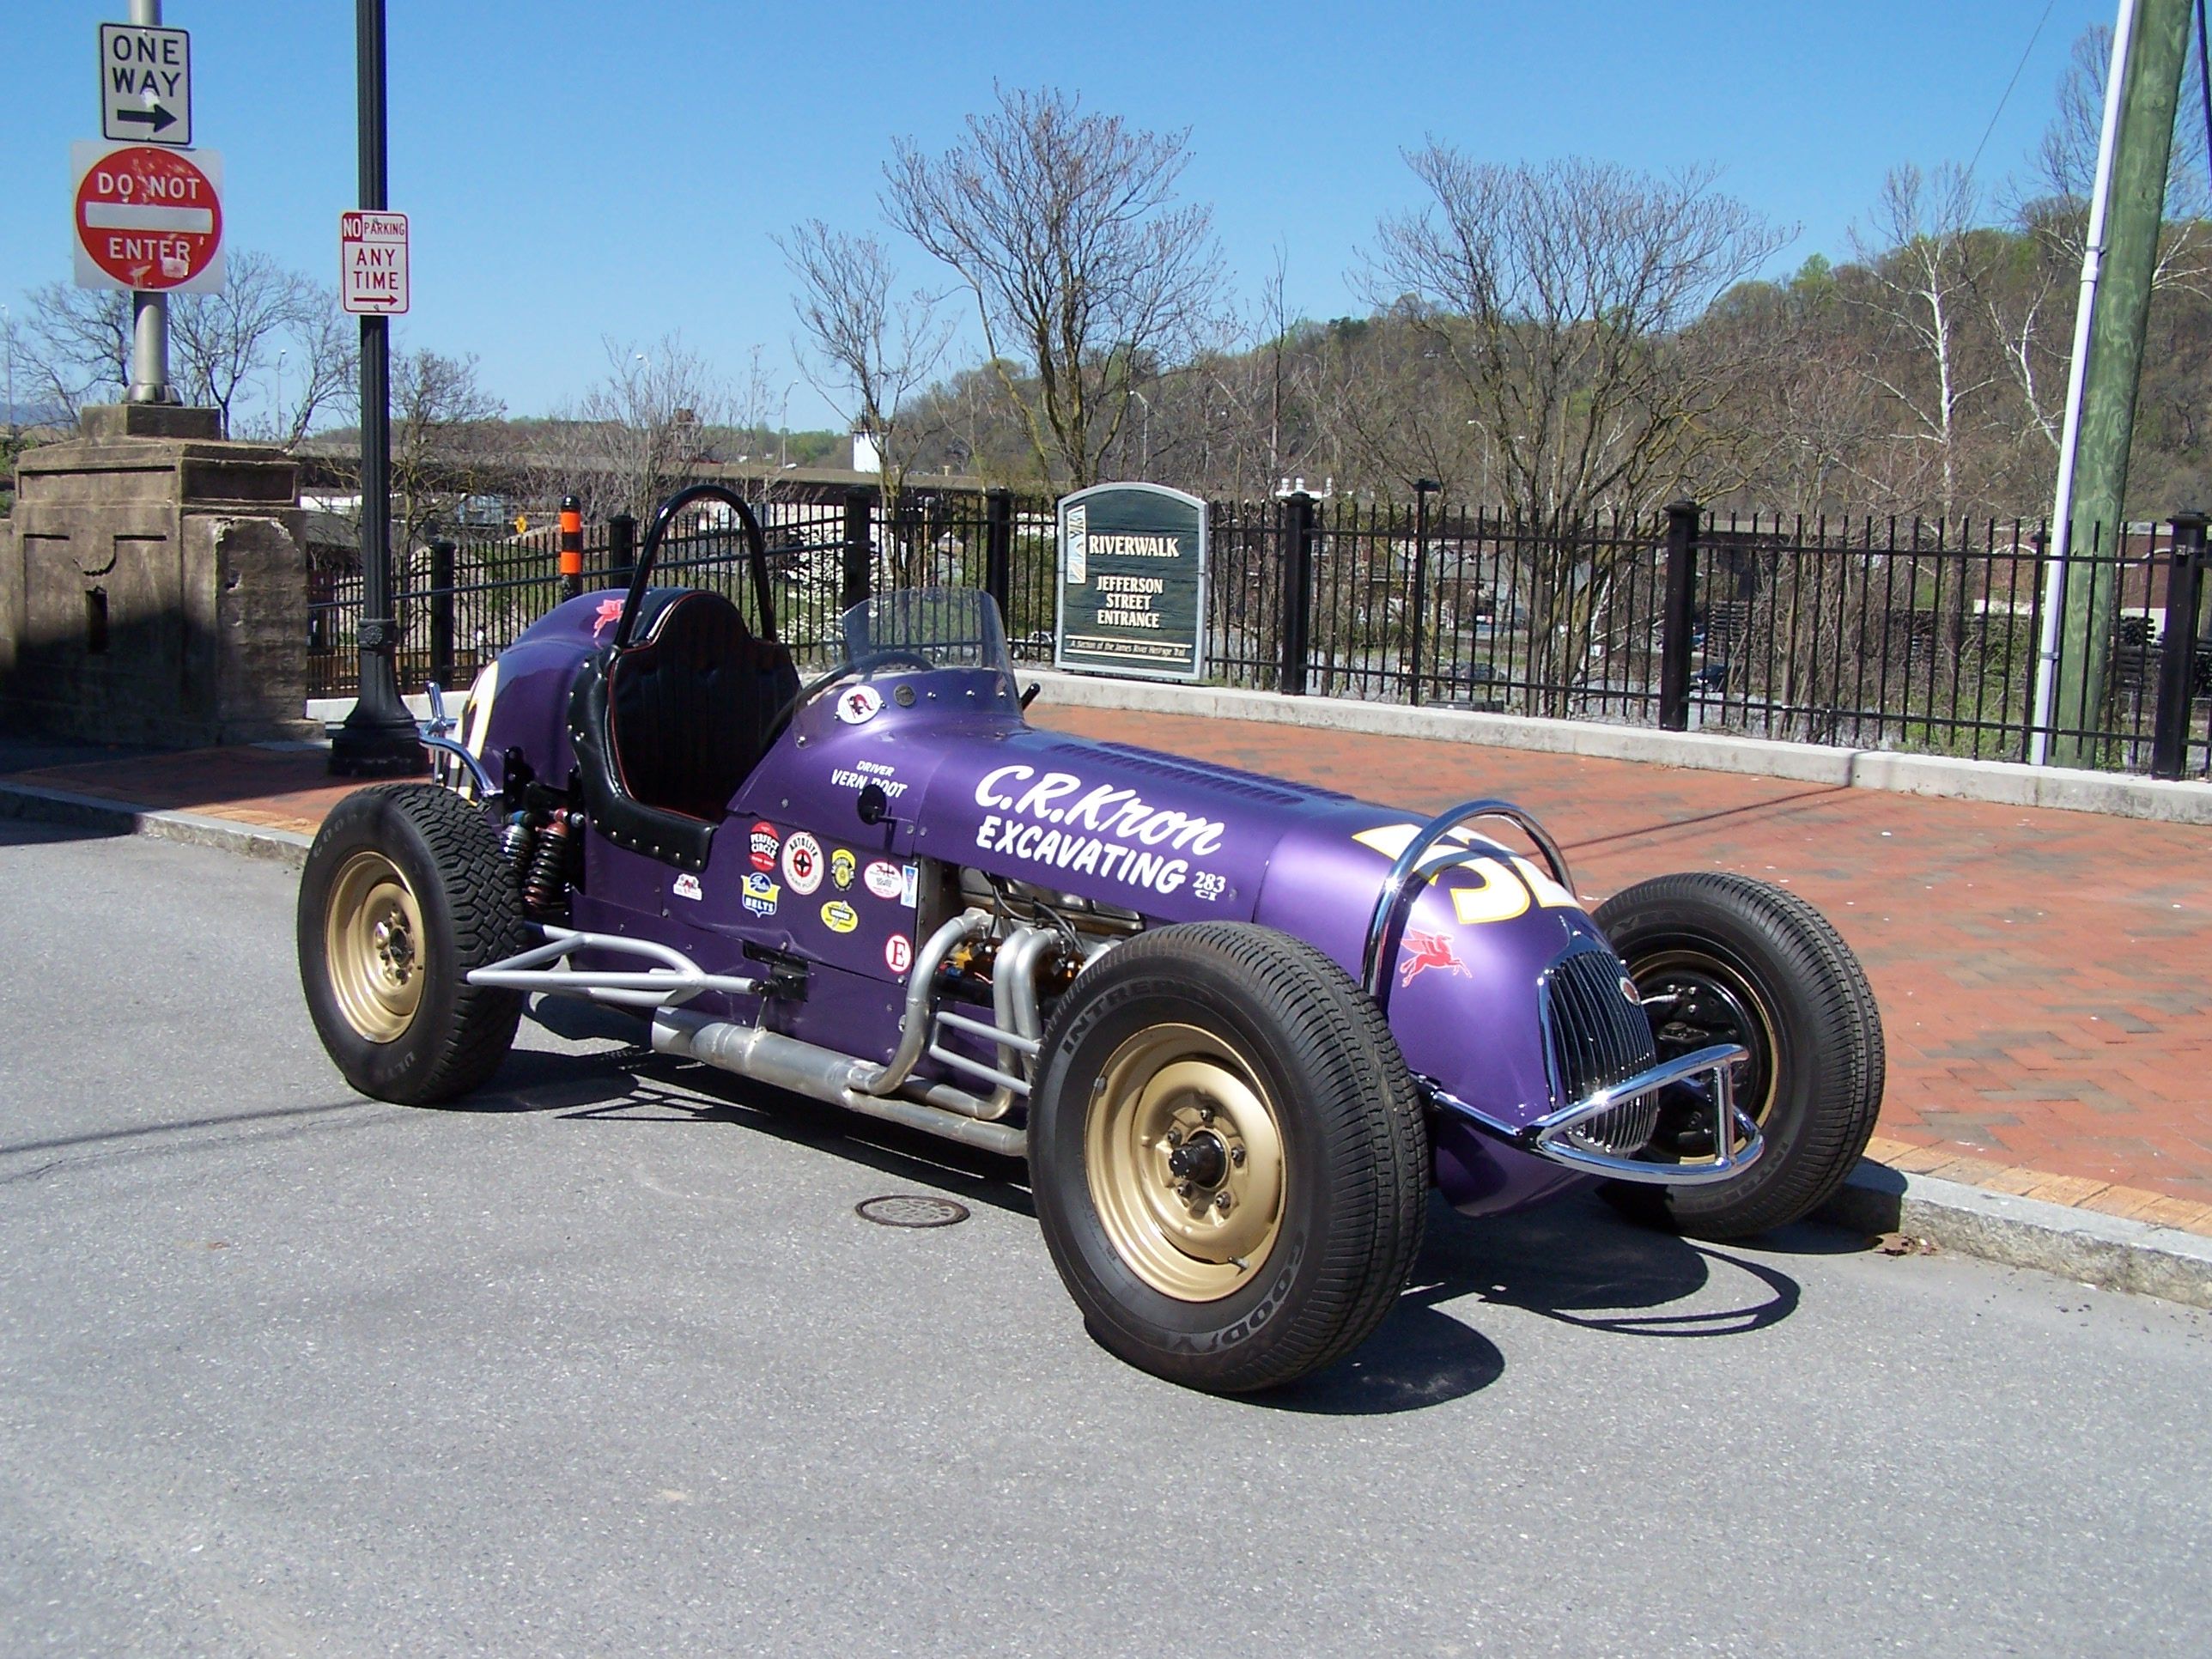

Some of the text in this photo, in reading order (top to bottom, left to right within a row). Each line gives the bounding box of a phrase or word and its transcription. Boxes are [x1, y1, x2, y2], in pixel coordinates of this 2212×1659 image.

[112, 34, 180, 66] ONE
[112, 67, 181, 98] WAY
[97, 172, 201, 200] DO NOT
[343, 217, 405, 239] NO PARKING
[109, 237, 191, 263] ENTER
[356, 248, 396, 267] ANY
[353, 270, 398, 291] TIME
[1089, 535, 1180, 558] RIVERWALK
[1097, 576, 1164, 594] JEFFERSON
[1106, 593, 1152, 611] STREET
[1097, 610, 1160, 628] ENTRANCE
[856, 760, 895, 777] DRIVER
[831, 769, 868, 790] VERN
[750, 833, 780, 850] PERFECT
[750, 842, 777, 860] CIRCLE
[789, 836, 818, 857] AUTOLITE
[975, 815, 1188, 894] EXCAVATING
[1192, 871, 1226, 893] 283
[745, 896, 775, 912] BELTS
[891, 940, 905, 967] E
